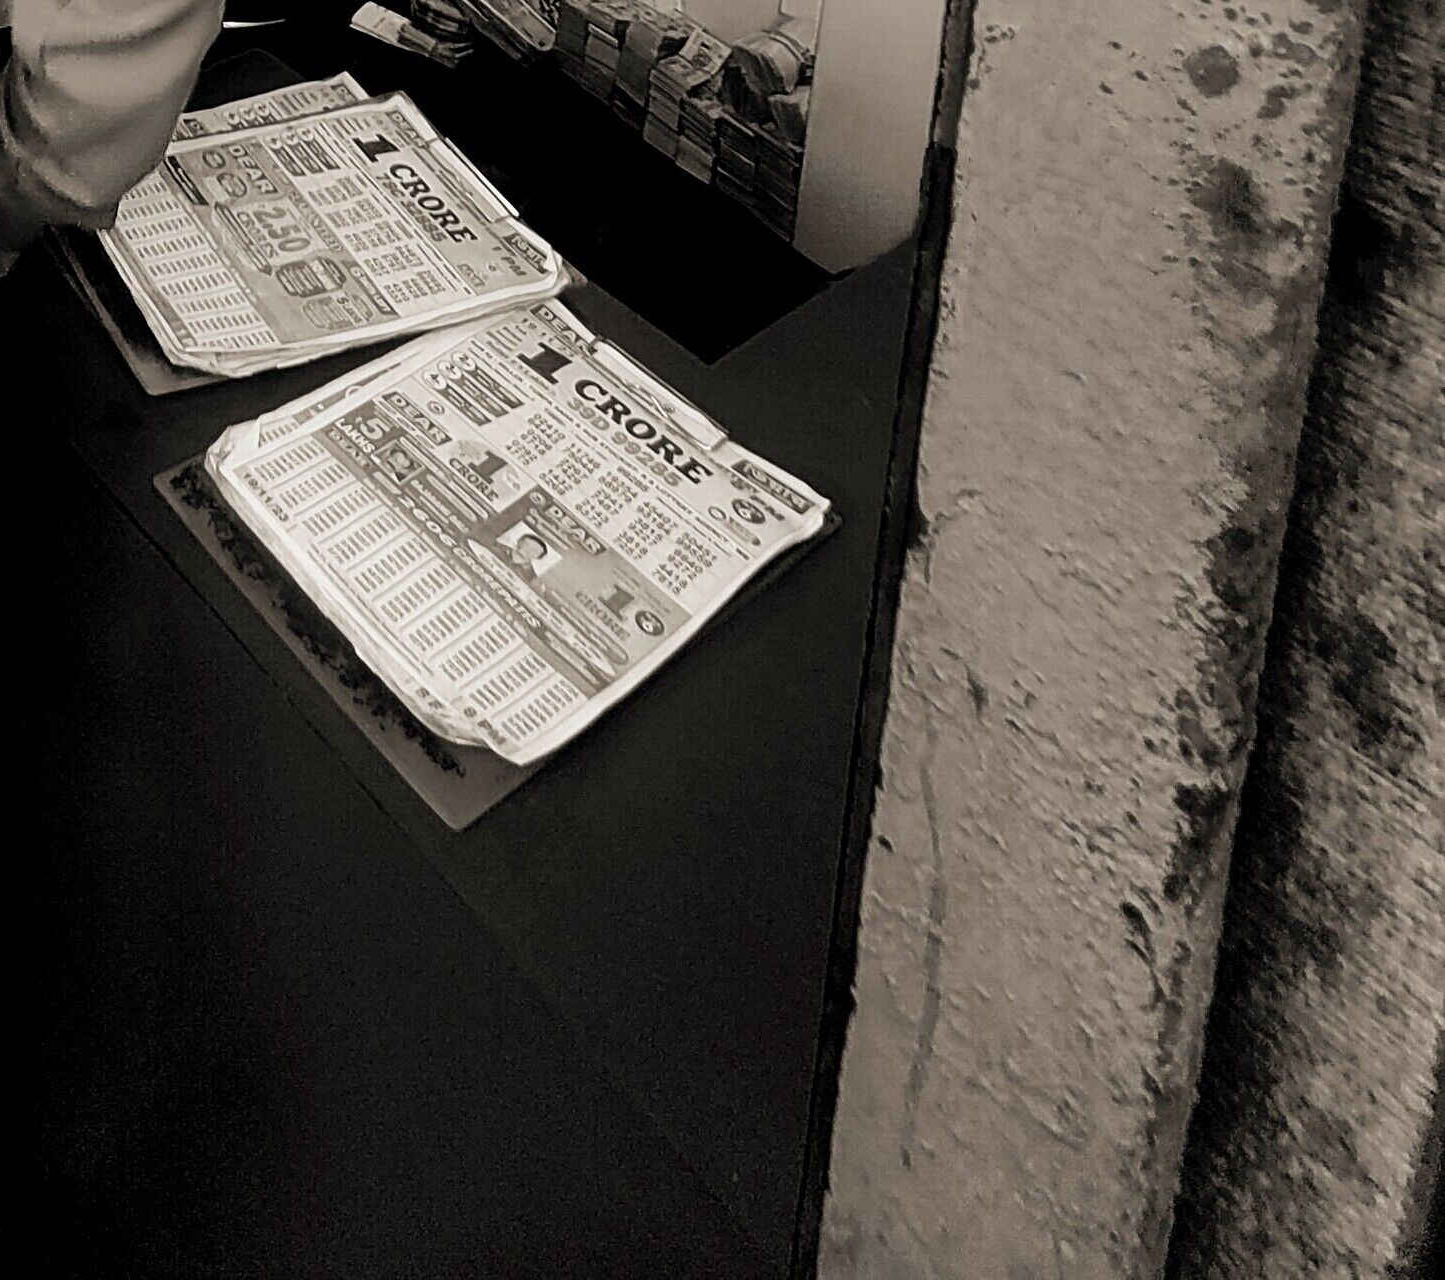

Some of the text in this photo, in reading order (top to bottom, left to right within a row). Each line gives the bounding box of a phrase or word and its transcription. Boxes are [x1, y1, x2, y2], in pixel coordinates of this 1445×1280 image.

[227, 144, 278, 193] DEAR
[390, 163, 477, 244] CRORE
[334, 417, 377, 455] LAKHS
[389, 393, 448, 443] DEAR
[576, 377, 713, 485] CRORE
[448, 457, 500, 502] CRORE
[612, 430, 683, 488] 99285
